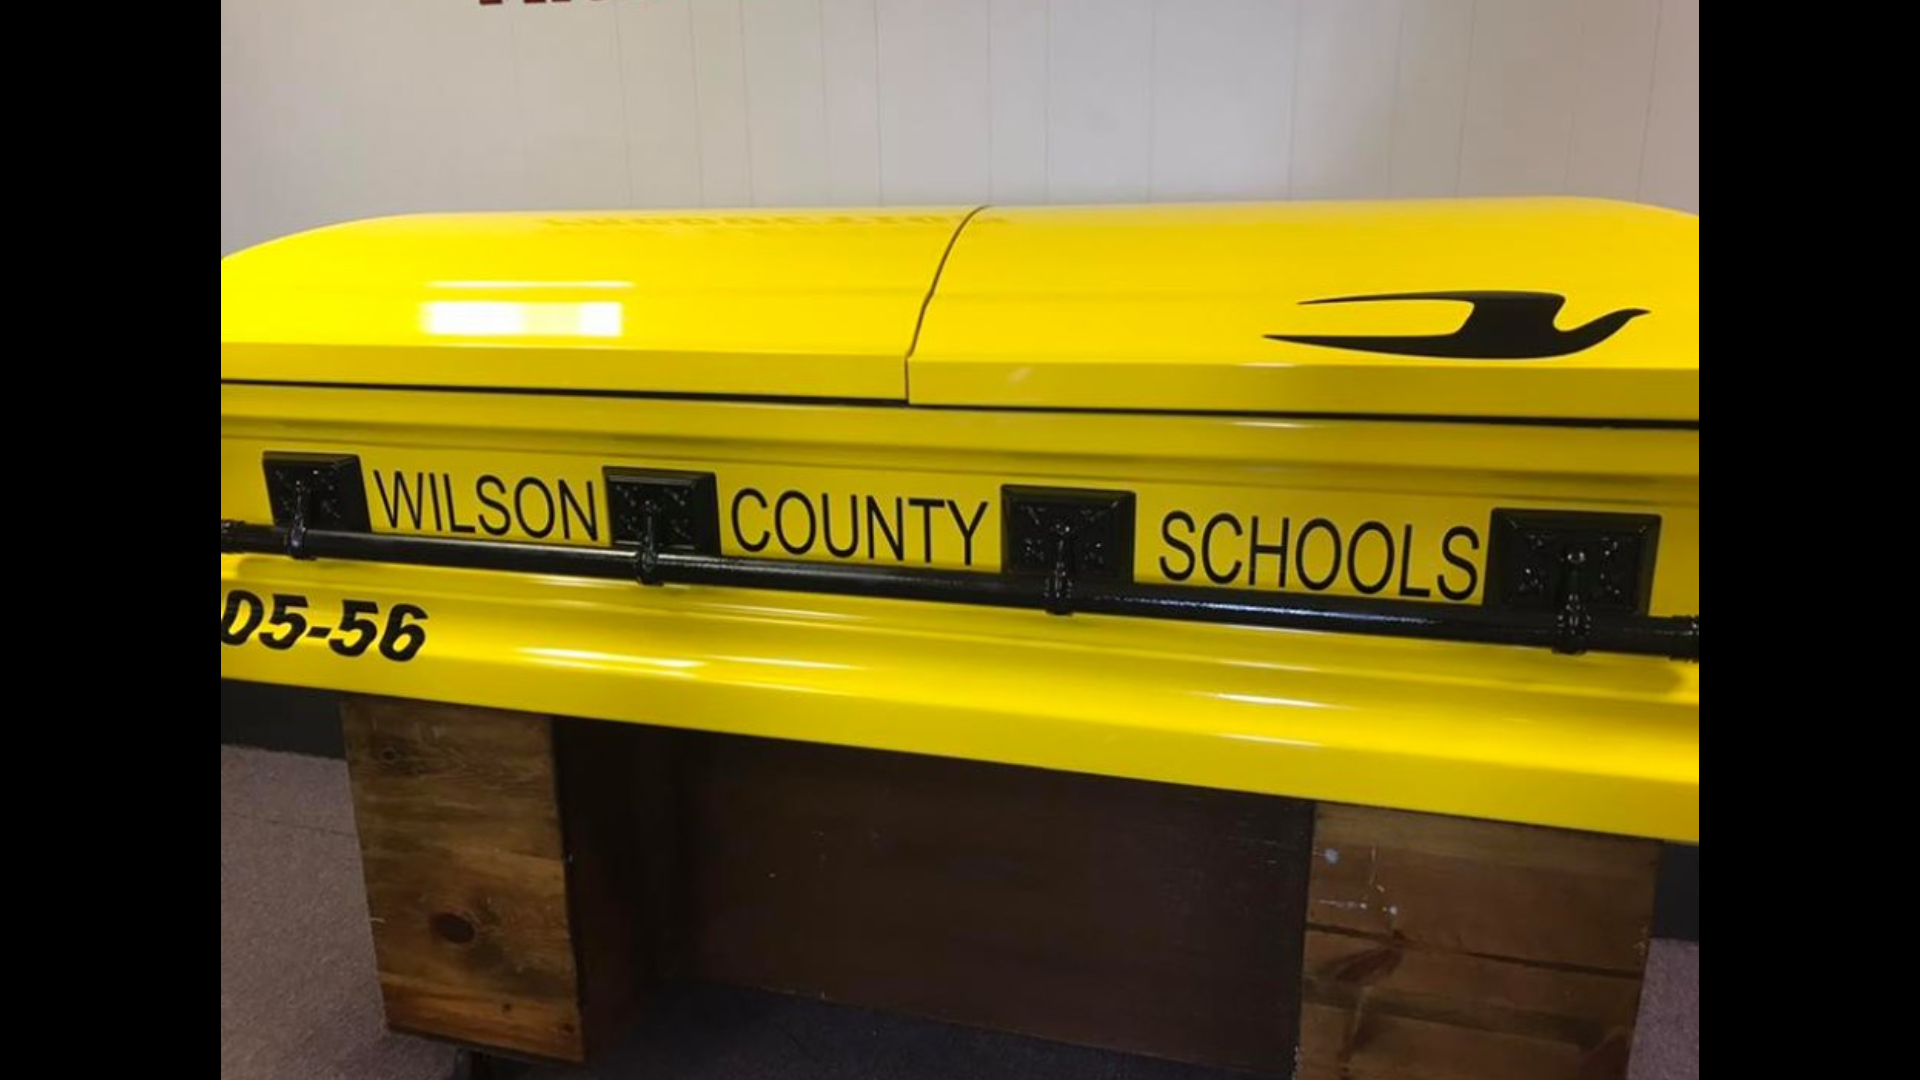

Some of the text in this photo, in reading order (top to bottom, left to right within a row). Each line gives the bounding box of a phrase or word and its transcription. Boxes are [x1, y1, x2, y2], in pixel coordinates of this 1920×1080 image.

[373, 469, 1480, 601] WILSON COUNTY SCHOOLS
